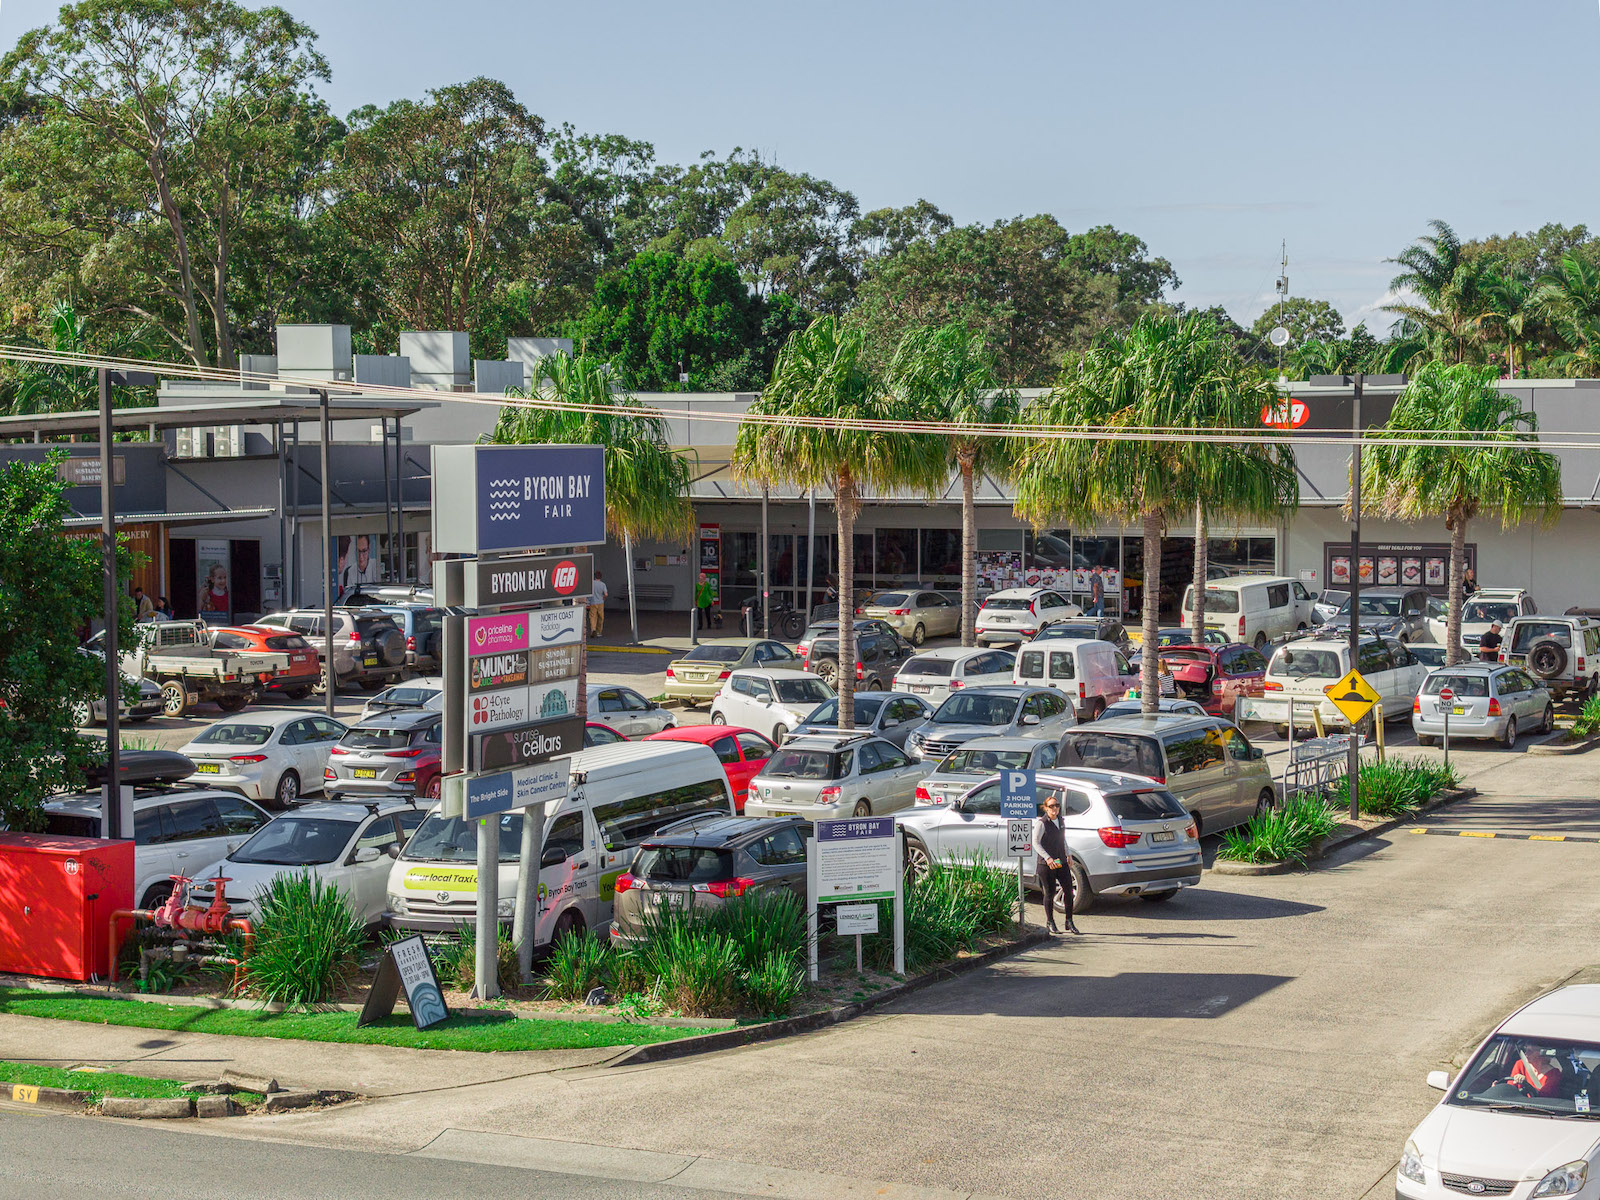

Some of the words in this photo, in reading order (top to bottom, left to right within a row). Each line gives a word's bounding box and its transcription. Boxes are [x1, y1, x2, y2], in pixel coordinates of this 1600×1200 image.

[524, 476, 563, 500] BYRON
[568, 475, 590, 498] BAY
[544, 504, 572, 518] FAIR
[704, 546, 715, 556] 10
[492, 571, 526, 594] BYRON
[528, 569, 547, 590] BAY
[554, 566, 576, 588] IGA
[541, 613, 557, 622] NORTH
[558, 611, 574, 620] COAST
[488, 624, 512, 636] priceline
[541, 622, 560, 632] Radiology
[488, 634, 512, 645] pharmacy
[546, 649, 566, 658] SUNDAY
[480, 654, 519, 678] MUNCH
[538, 657, 574, 670] SUSTAINABLE
[545, 668, 566, 678] BAKERY
[480, 677, 492, 687] JUICE
[542, 690, 567, 701] FRESH
[490, 695, 511, 709] 4Cyte
[490, 708, 524, 723] Pathology
[513, 728, 539, 743] sunrise
[522, 735, 561, 757] cellars
[517, 777, 538, 787] Medical
[539, 774, 553, 783] Clinic
[1009, 772, 1027, 792] P
[480, 791, 496, 801] Bright
[497, 789, 508, 797] Side
[517, 789, 529, 798] Skin
[530, 786, 548, 795] Cancer
[550, 781, 566, 790] Centre
[848, 823, 867, 831] BYRON
[1012, 824, 1028, 832] ONE
[66, 862, 77, 871] FH
[429, 874, 452, 882] local
[454, 875, 473, 883] Taxi
[549, 887, 564, 898] Byron
[564, 884, 574, 894] Bay
[575, 880, 587, 889] Taxis
[602, 882, 615, 892] You
[397, 944, 420, 959] FRESH
[402, 966, 413, 976] OPEN
[413, 964, 416, 972] 7
[416, 960, 426, 971] DAYS
[414, 973, 420, 981] AM
[19, 1089, 32, 1100] SV
